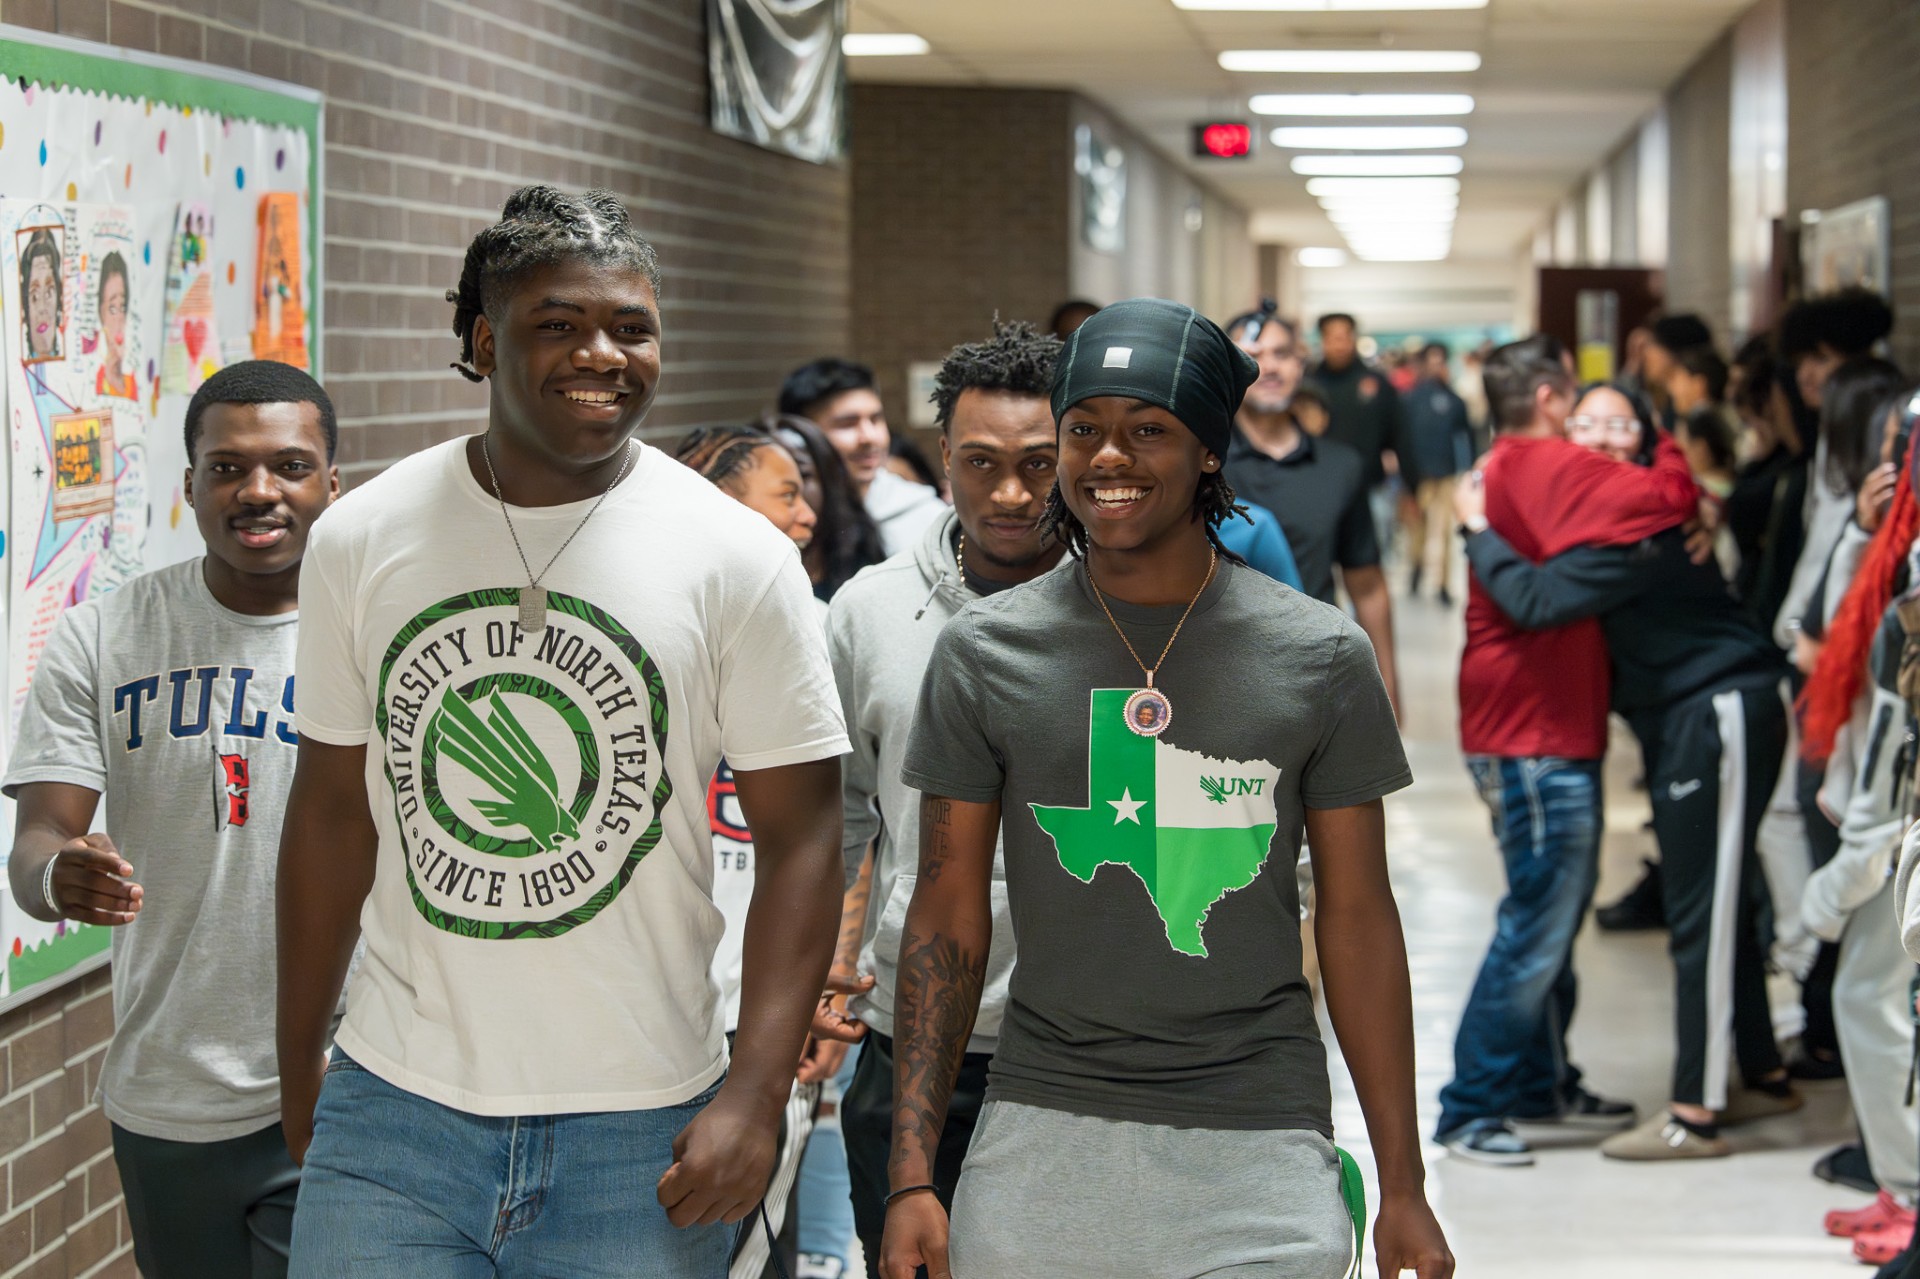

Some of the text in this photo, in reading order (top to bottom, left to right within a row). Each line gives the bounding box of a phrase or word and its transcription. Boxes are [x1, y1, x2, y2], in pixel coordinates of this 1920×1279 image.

[391, 621, 647, 836] UNIVERSITY OF NORTH TEXAS
[1219, 777, 1266, 795] UNT
[416, 838, 596, 908] SINCE 1890
